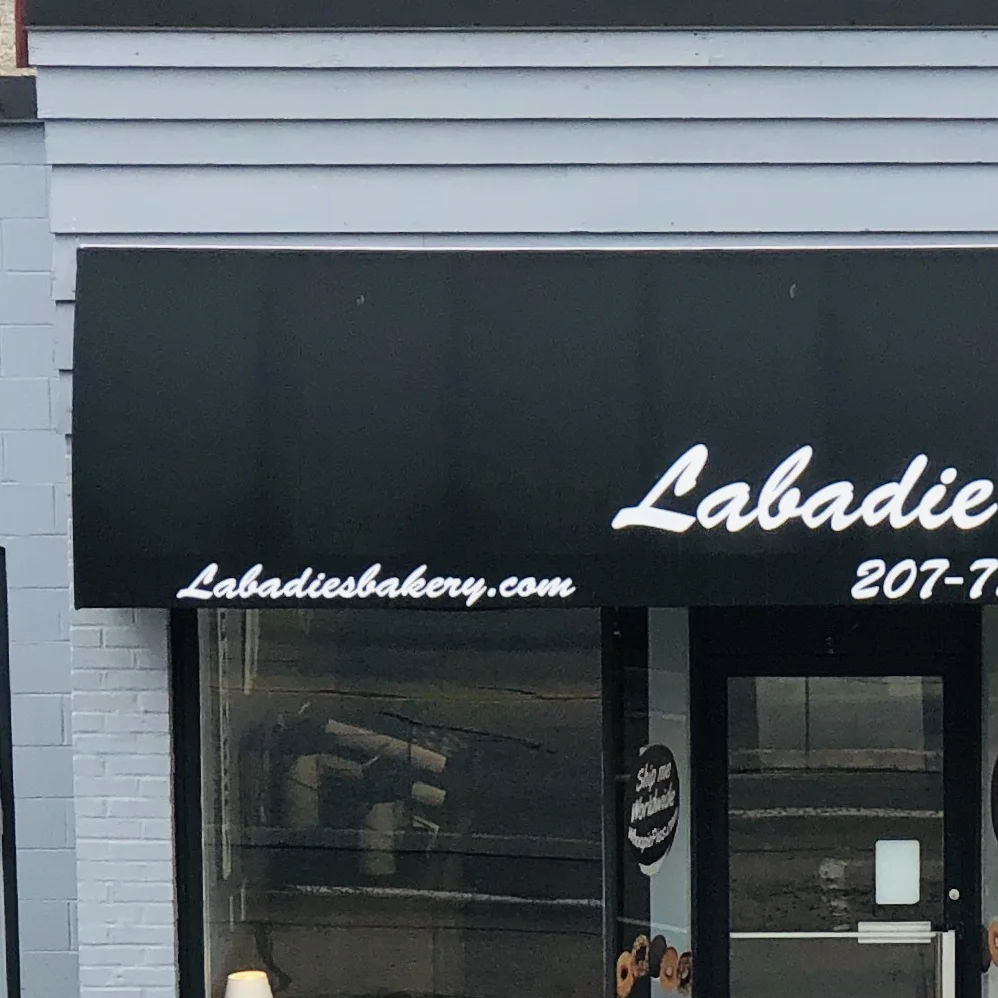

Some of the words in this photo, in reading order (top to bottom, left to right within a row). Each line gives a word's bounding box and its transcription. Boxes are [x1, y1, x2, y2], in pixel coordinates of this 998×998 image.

[176, 562, 576, 605] Labadiesbakery.com
[636, 763, 657, 792] Ship
[657, 763, 672, 782] me
[630, 782, 676, 823] Worldwide
